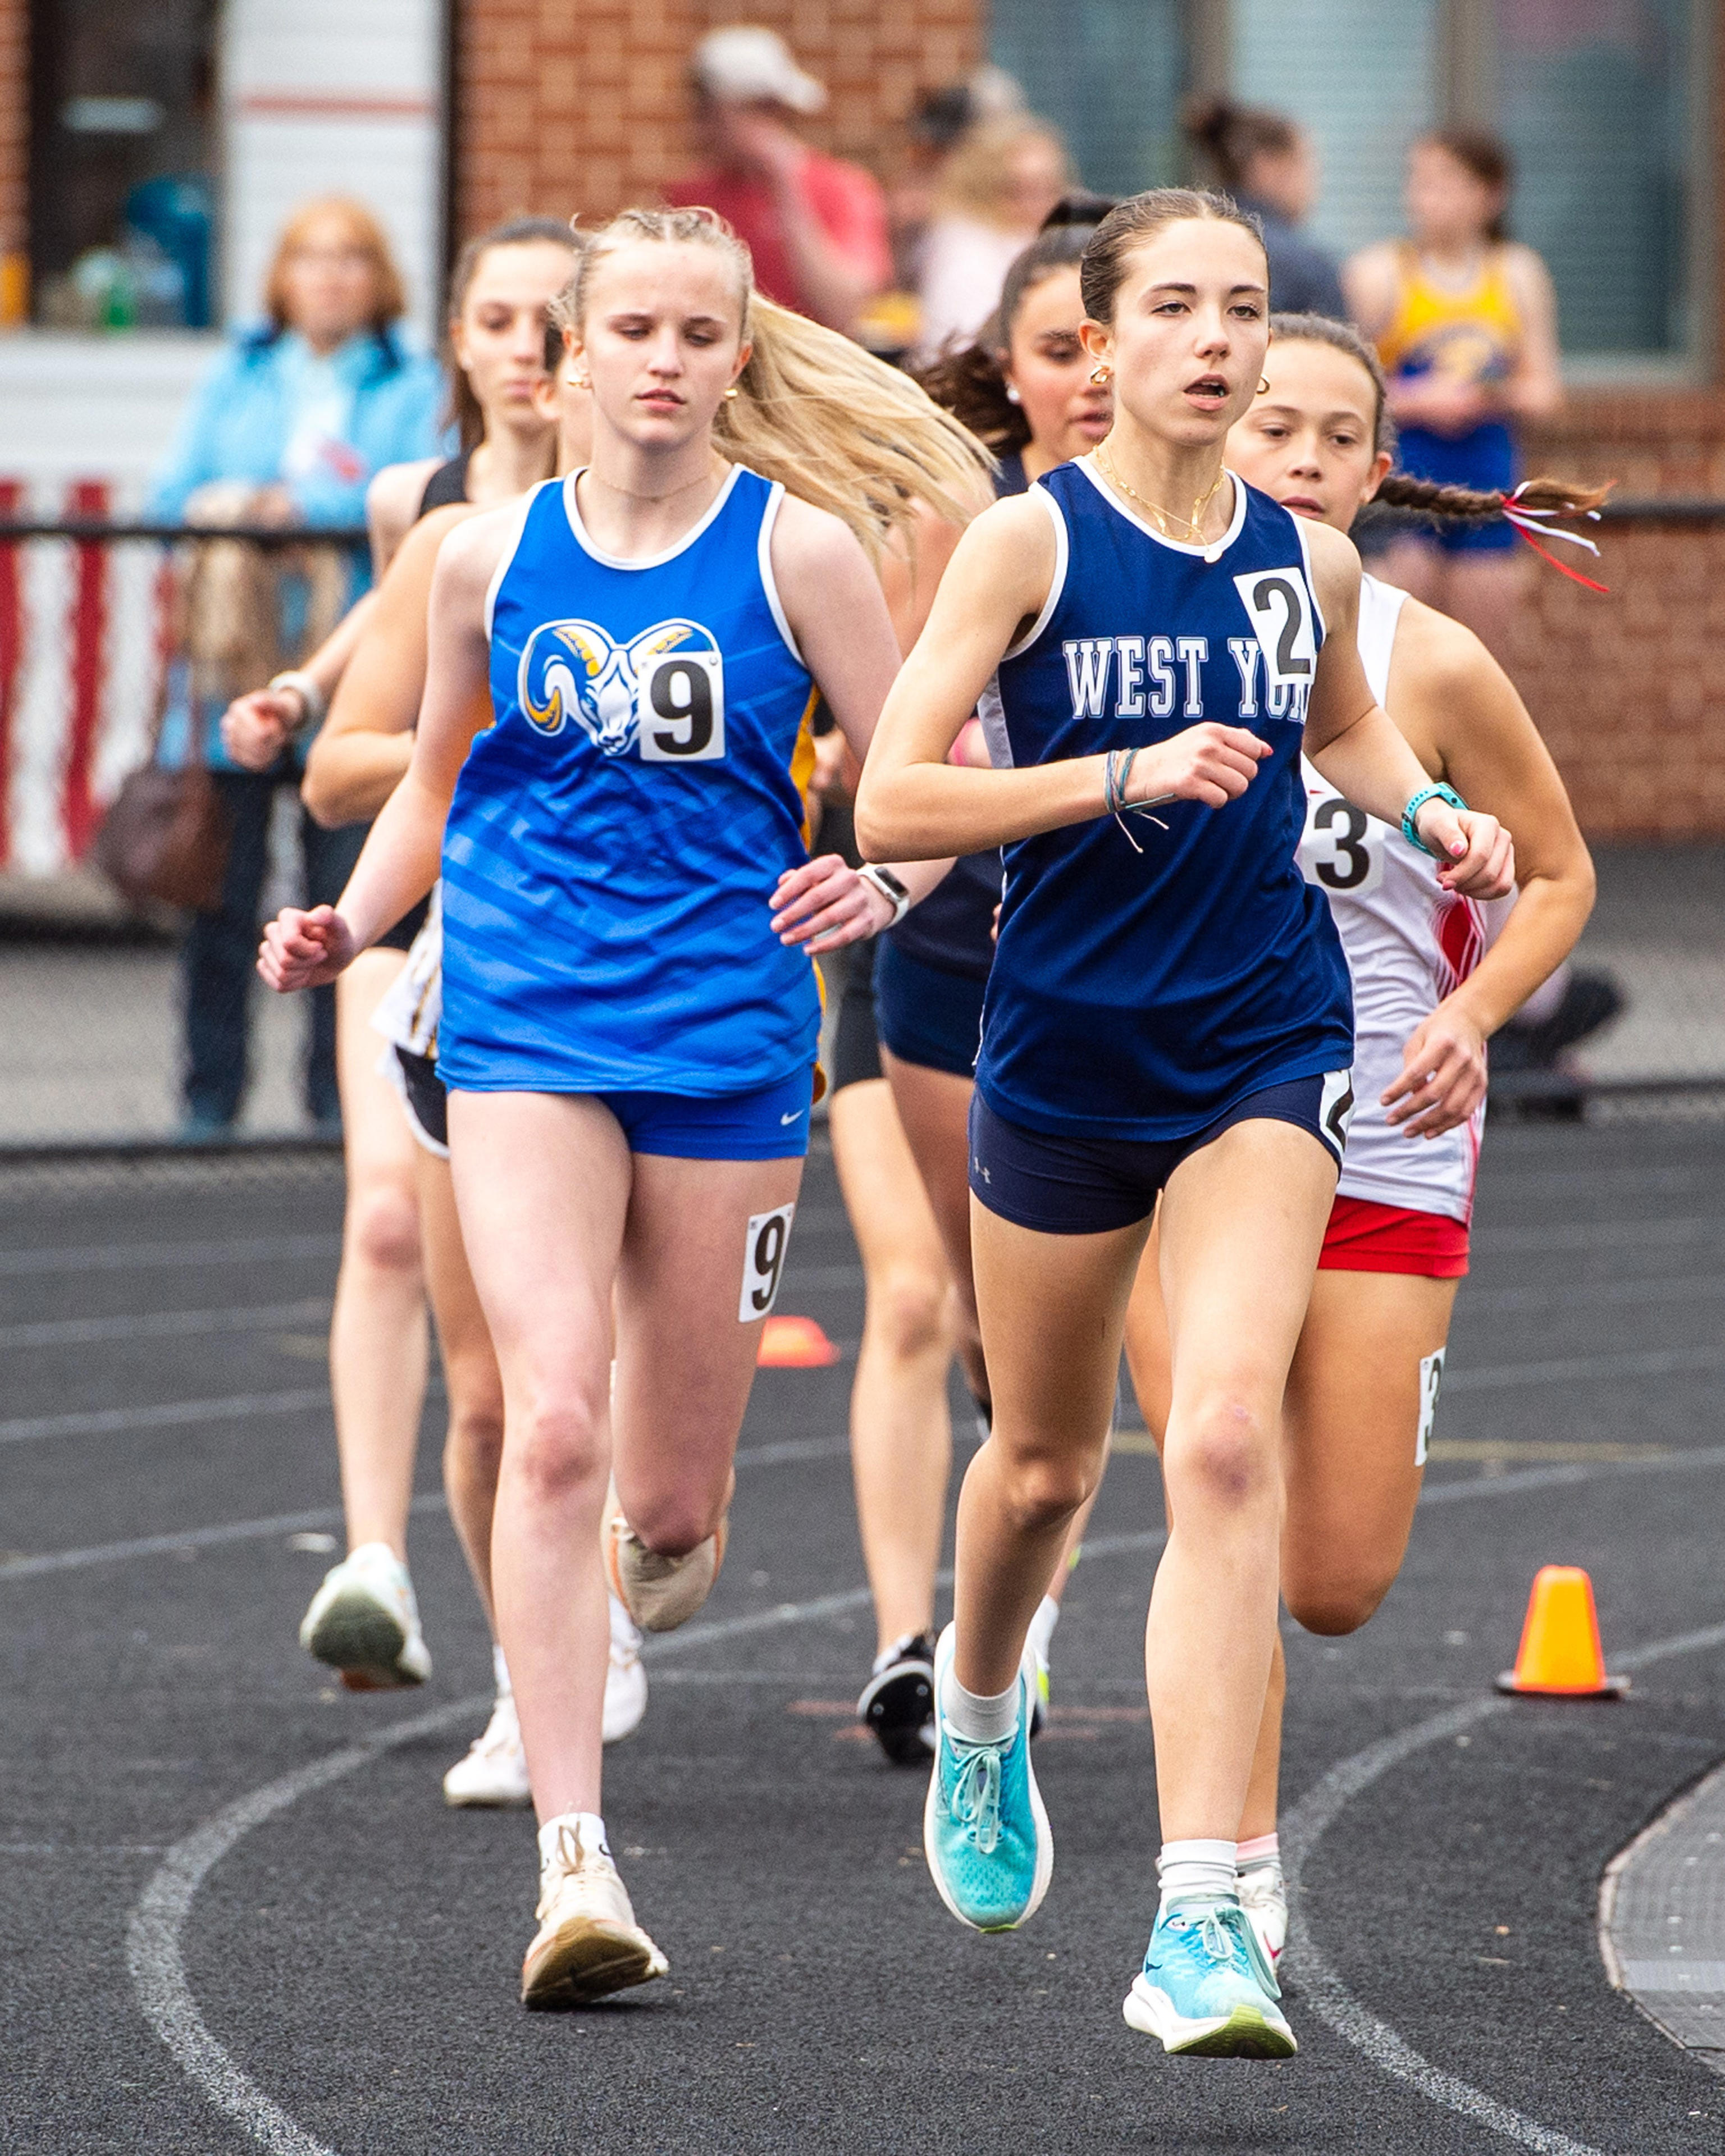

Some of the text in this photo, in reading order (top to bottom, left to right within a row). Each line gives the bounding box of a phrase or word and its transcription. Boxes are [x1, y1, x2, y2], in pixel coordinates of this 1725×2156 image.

[1253, 577, 1311, 675] 2
[650, 660, 713, 755] 9
[1062, 636, 1208, 719] WEST
[1314, 798, 1370, 889] 3
[752, 1215, 784, 1310] 9
